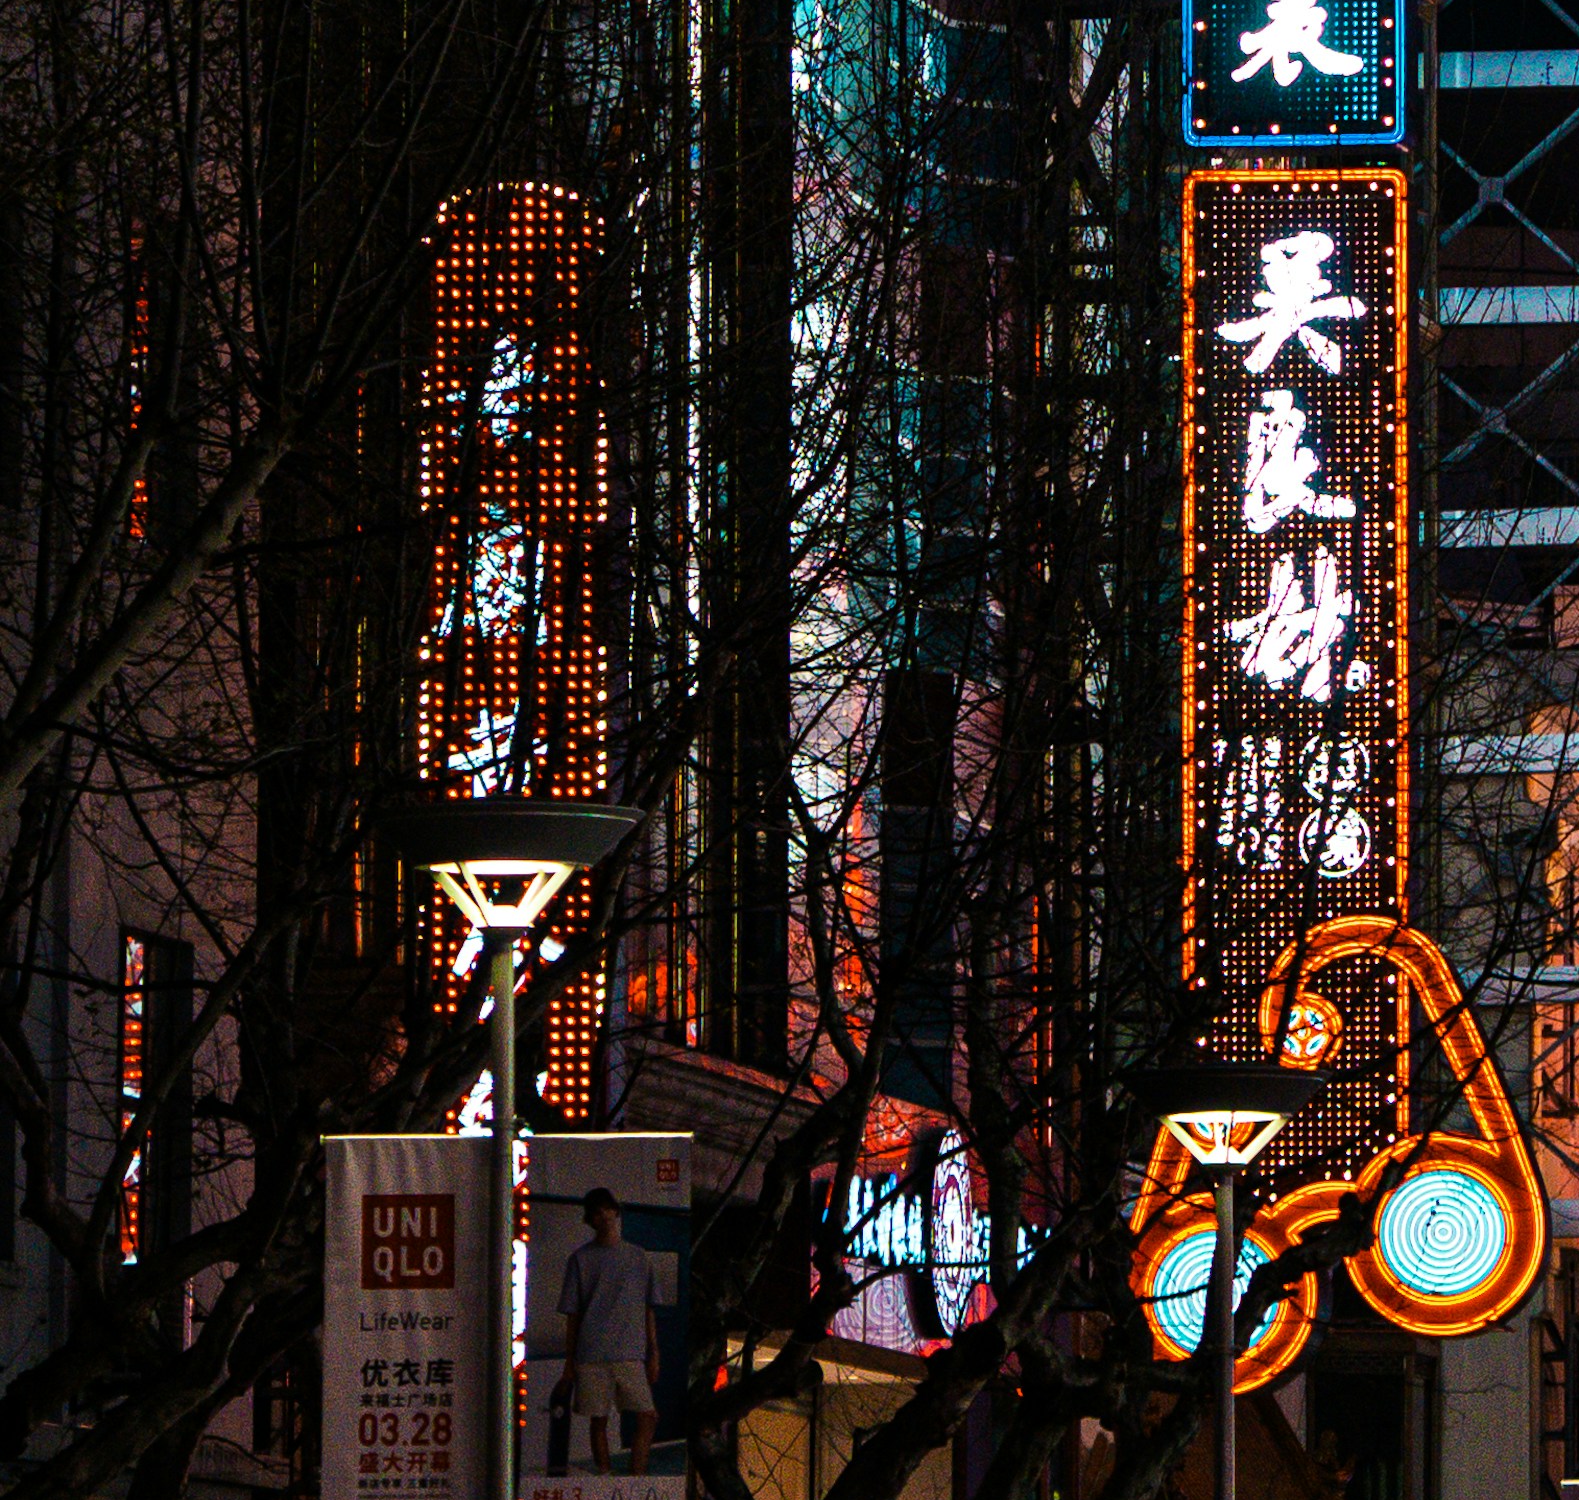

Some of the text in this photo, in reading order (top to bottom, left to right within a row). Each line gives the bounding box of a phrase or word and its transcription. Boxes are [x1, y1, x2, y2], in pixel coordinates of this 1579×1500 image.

[373, 1206, 438, 1238] UNI
[373, 1246, 444, 1283] QLO
[360, 1312, 454, 1331] LifeWear
[361, 1358, 454, 1387] 优衣库
[358, 1412, 452, 1446] 03.28
[359, 1451, 451, 1473] 盛大开幕
